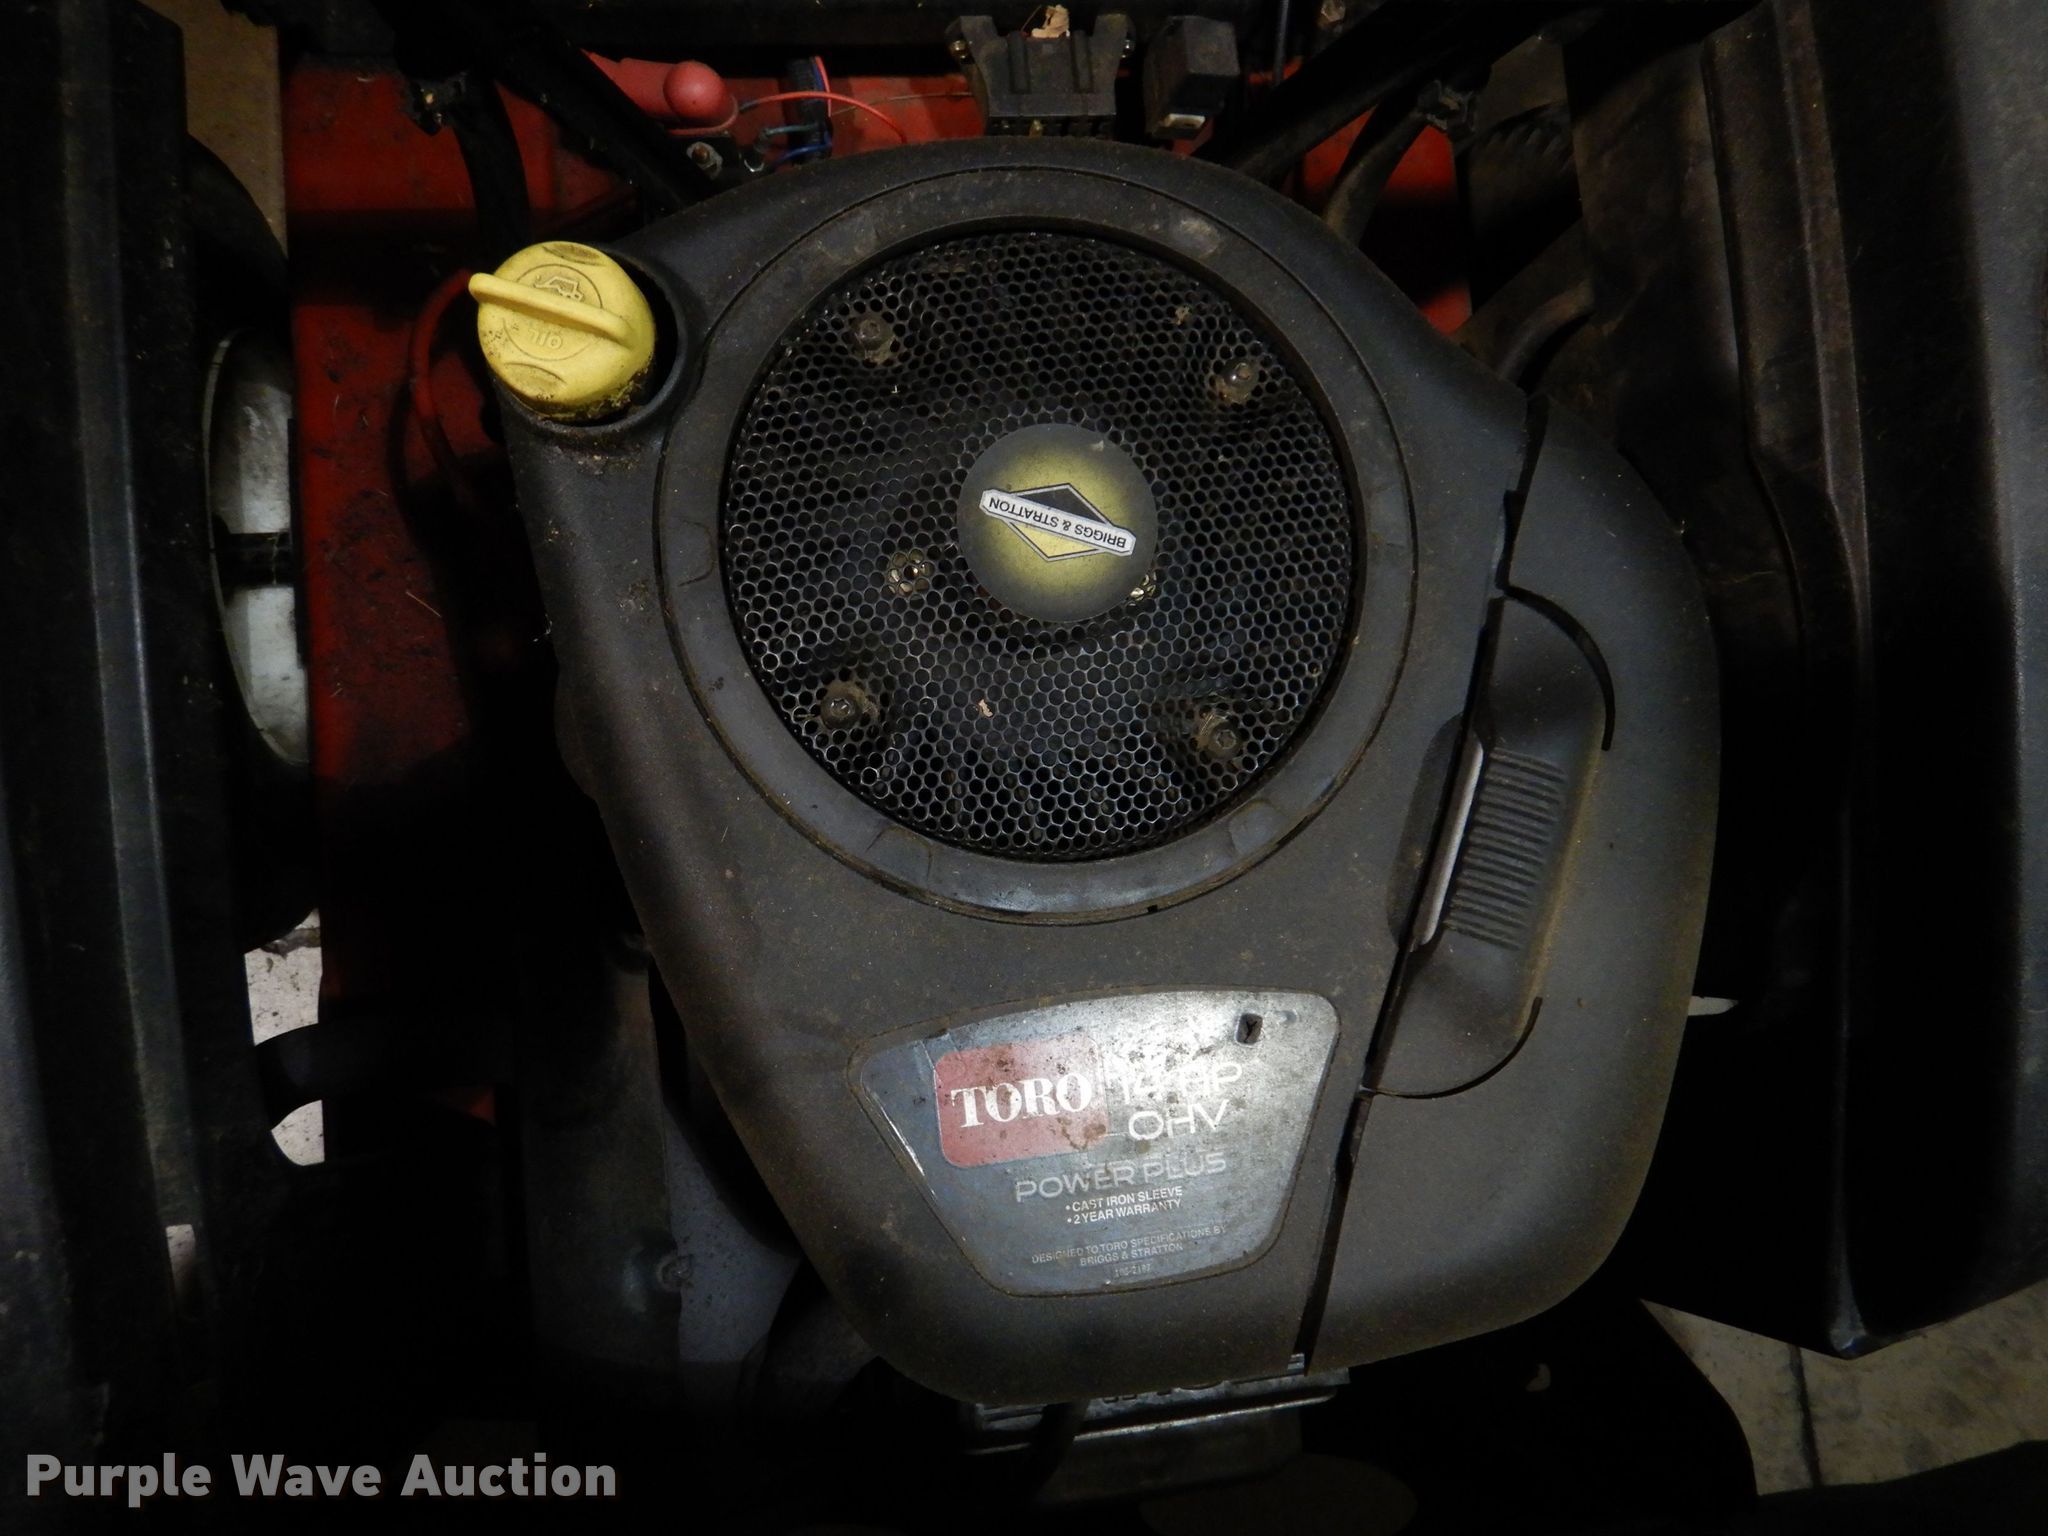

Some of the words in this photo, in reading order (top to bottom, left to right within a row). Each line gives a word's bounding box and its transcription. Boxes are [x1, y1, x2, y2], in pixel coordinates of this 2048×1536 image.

[988, 497, 1060, 528] STRATTON
[1062, 520, 1072, 532] &
[1074, 523, 1127, 549] BRIGGS
[950, 1072, 1095, 1128] TORO
[1129, 1099, 1230, 1140] OHV
[1014, 1164, 1135, 1203] POWER
[1143, 1151, 1226, 1184] PLUS
[1072, 1197, 1104, 1213] CAST
[1106, 1192, 1135, 1206] IRON
[1137, 1186, 1183, 1202] SLEEVE
[1073, 1214, 1081, 1225] 2
[1081, 1209, 1114, 1223] YEAR
[1115, 1200, 1181, 1218] WARRANTY
[1032, 1248, 1084, 1265] DESIGNED
[1086, 1244, 1099, 1255] TO
[1100, 1240, 1128, 1252] TORO
[1130, 1226, 1211, 1248] SPECIFICATIONS
[1212, 1224, 1227, 1235] BY
[1080, 1252, 1119, 1267] BRIGGS
[1121, 1251, 1129, 1261] &
[1131, 1242, 1184, 1259] STRATTON
